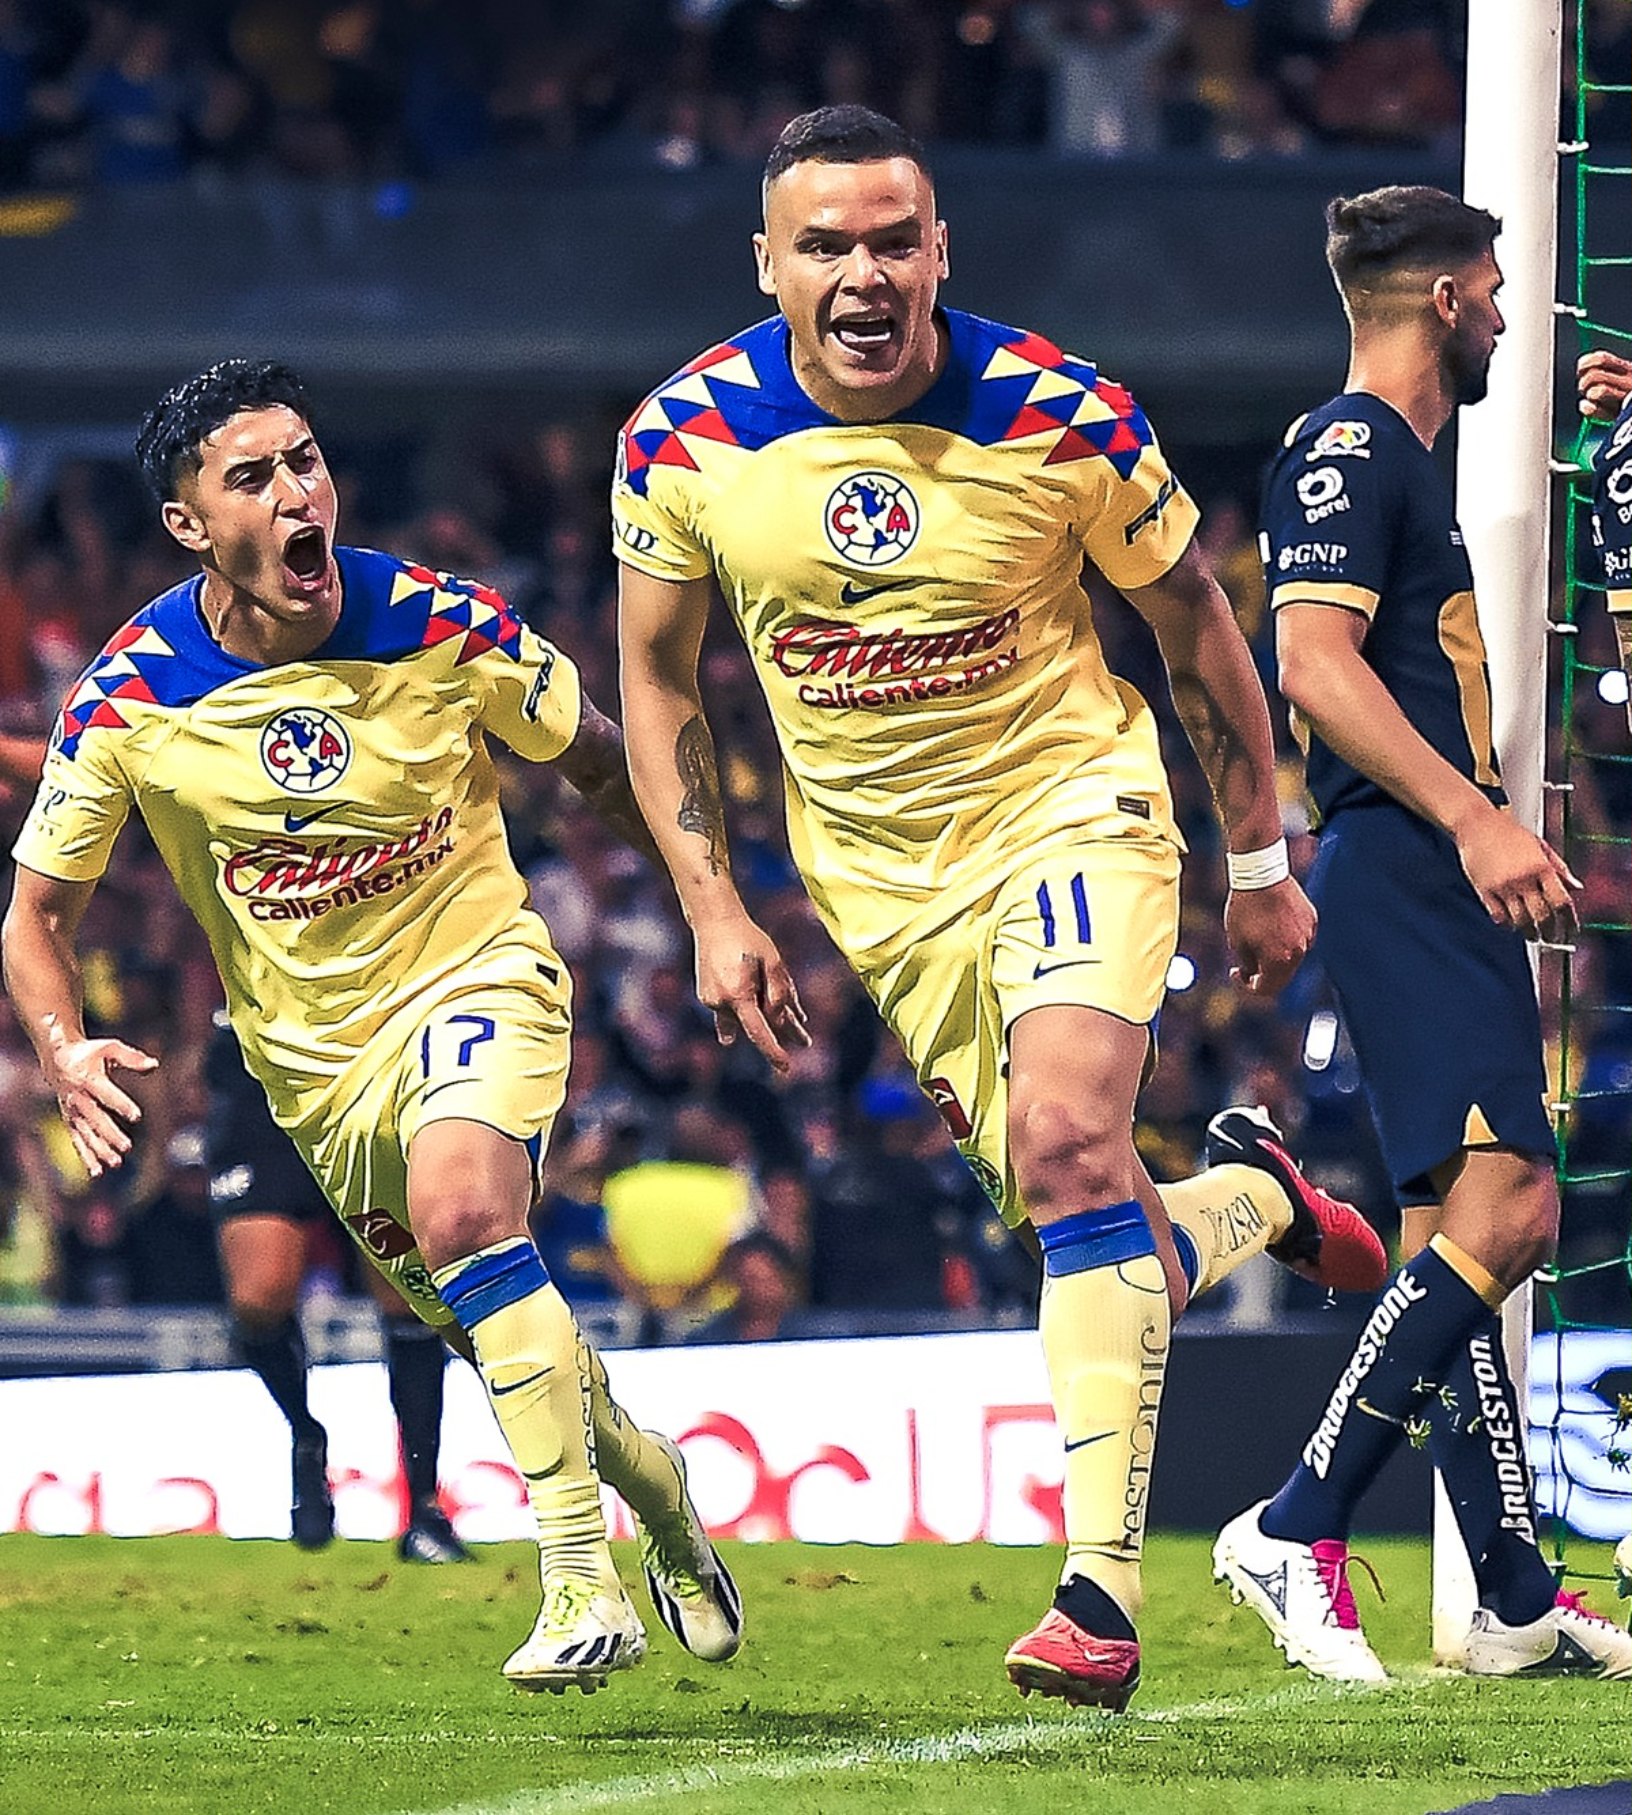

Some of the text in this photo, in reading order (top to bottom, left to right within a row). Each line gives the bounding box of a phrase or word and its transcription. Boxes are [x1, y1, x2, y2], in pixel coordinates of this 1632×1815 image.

[1294, 542, 1347, 565] GNP
[248, 838, 457, 921] caliente.mx
[1036, 871, 1092, 948] 11
[420, 1014, 496, 1080] 17
[1302, 1269, 1427, 1480] BRIDGESTONE
